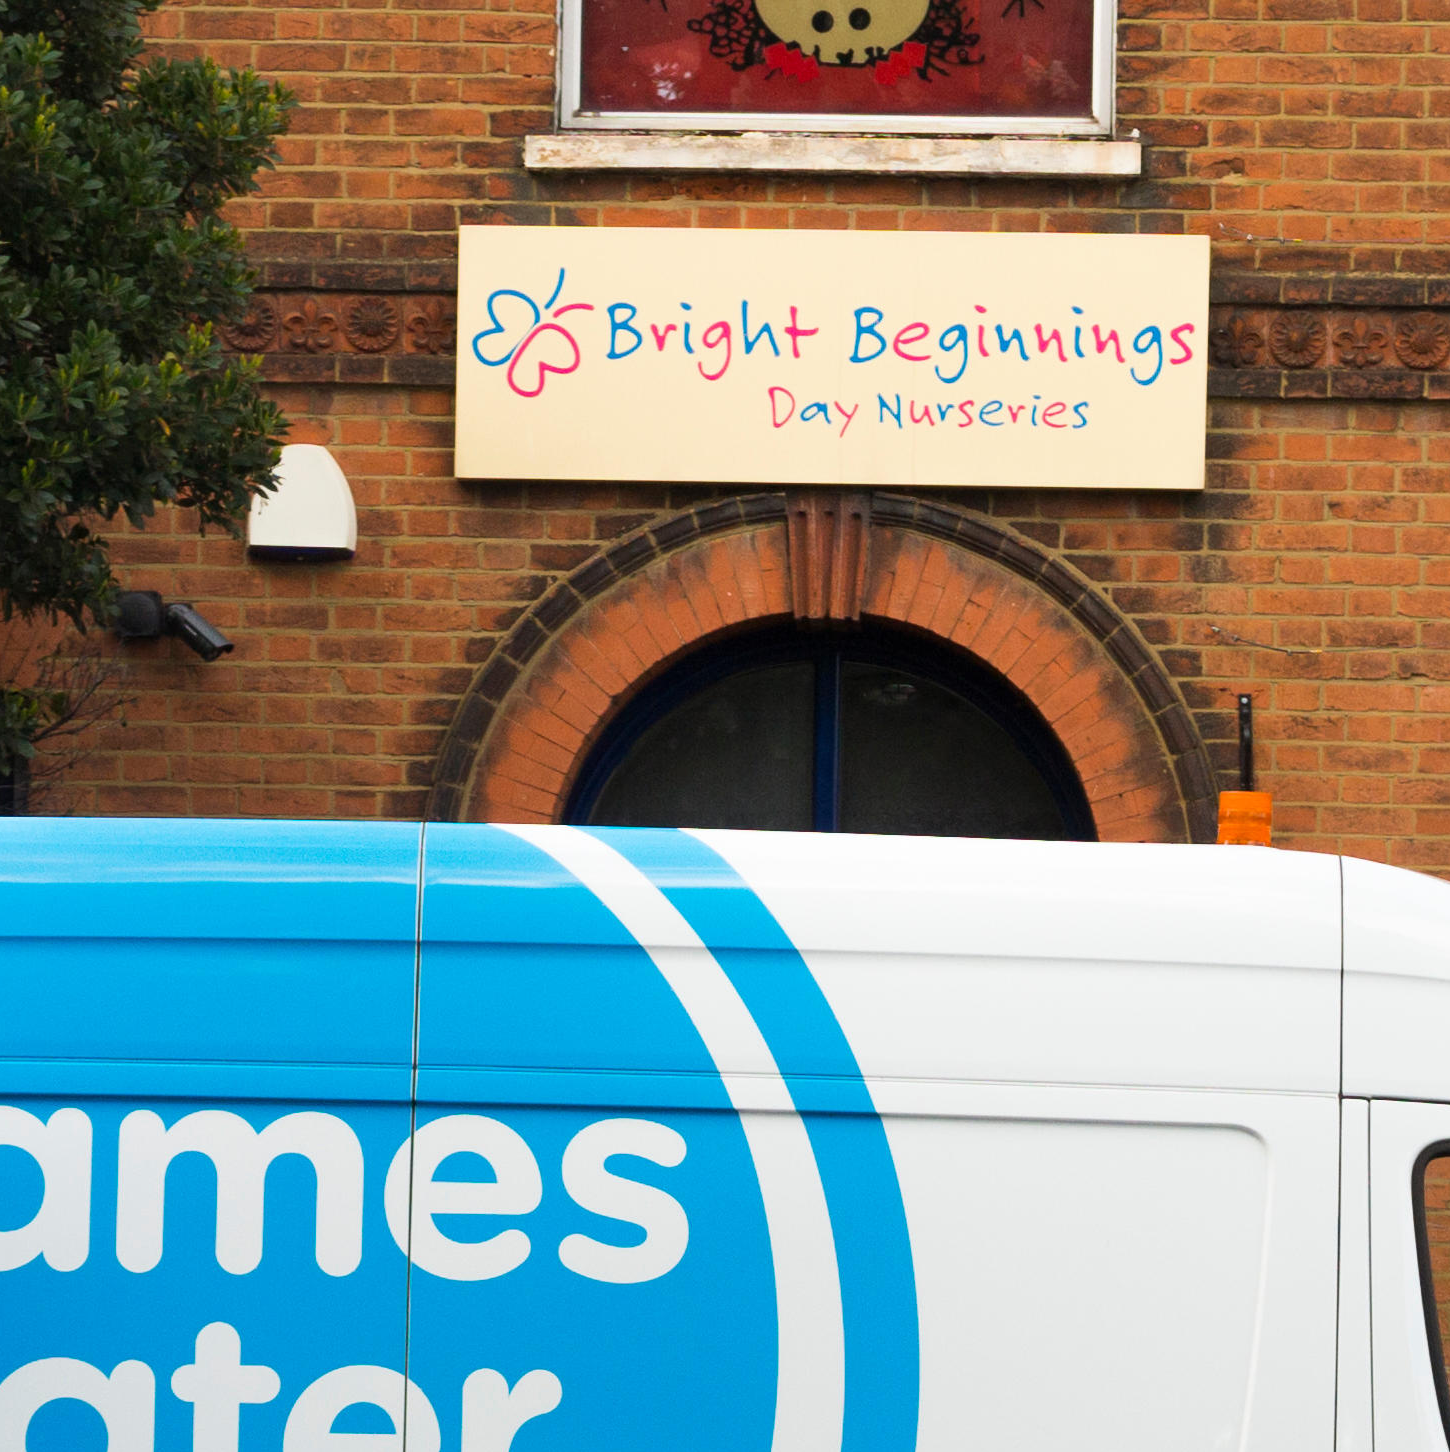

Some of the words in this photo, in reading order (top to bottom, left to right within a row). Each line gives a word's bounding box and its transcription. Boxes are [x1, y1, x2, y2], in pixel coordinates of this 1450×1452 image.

[606, 300, 819, 380] Bright
[850, 304, 1196, 386] Beginnings
[768, 386, 858, 438] Day
[877, 393, 1089, 430] Nurseries
